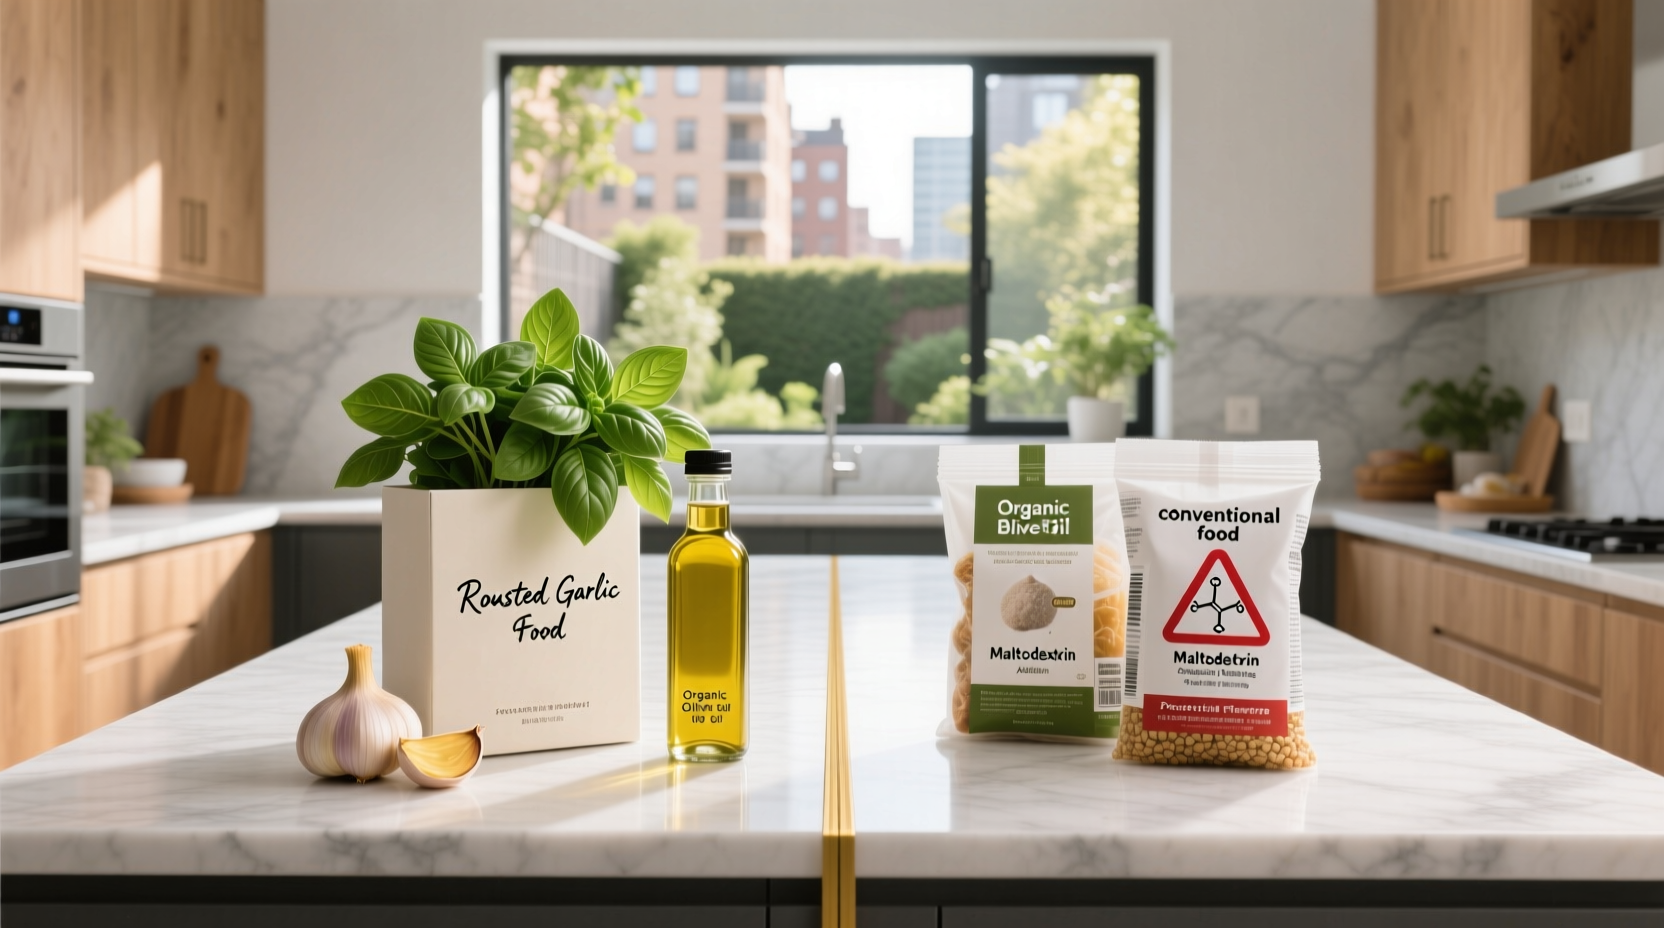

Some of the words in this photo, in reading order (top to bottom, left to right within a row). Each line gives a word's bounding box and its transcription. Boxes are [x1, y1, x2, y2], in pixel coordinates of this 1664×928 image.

[997, 499, 1070, 520] Organic
[1158, 507, 1280, 523] conventional
[1197, 525, 1239, 542] food
[556, 572, 620, 608] Garlic
[513, 612, 566, 642] Food
[683, 690, 727, 702] Organic
